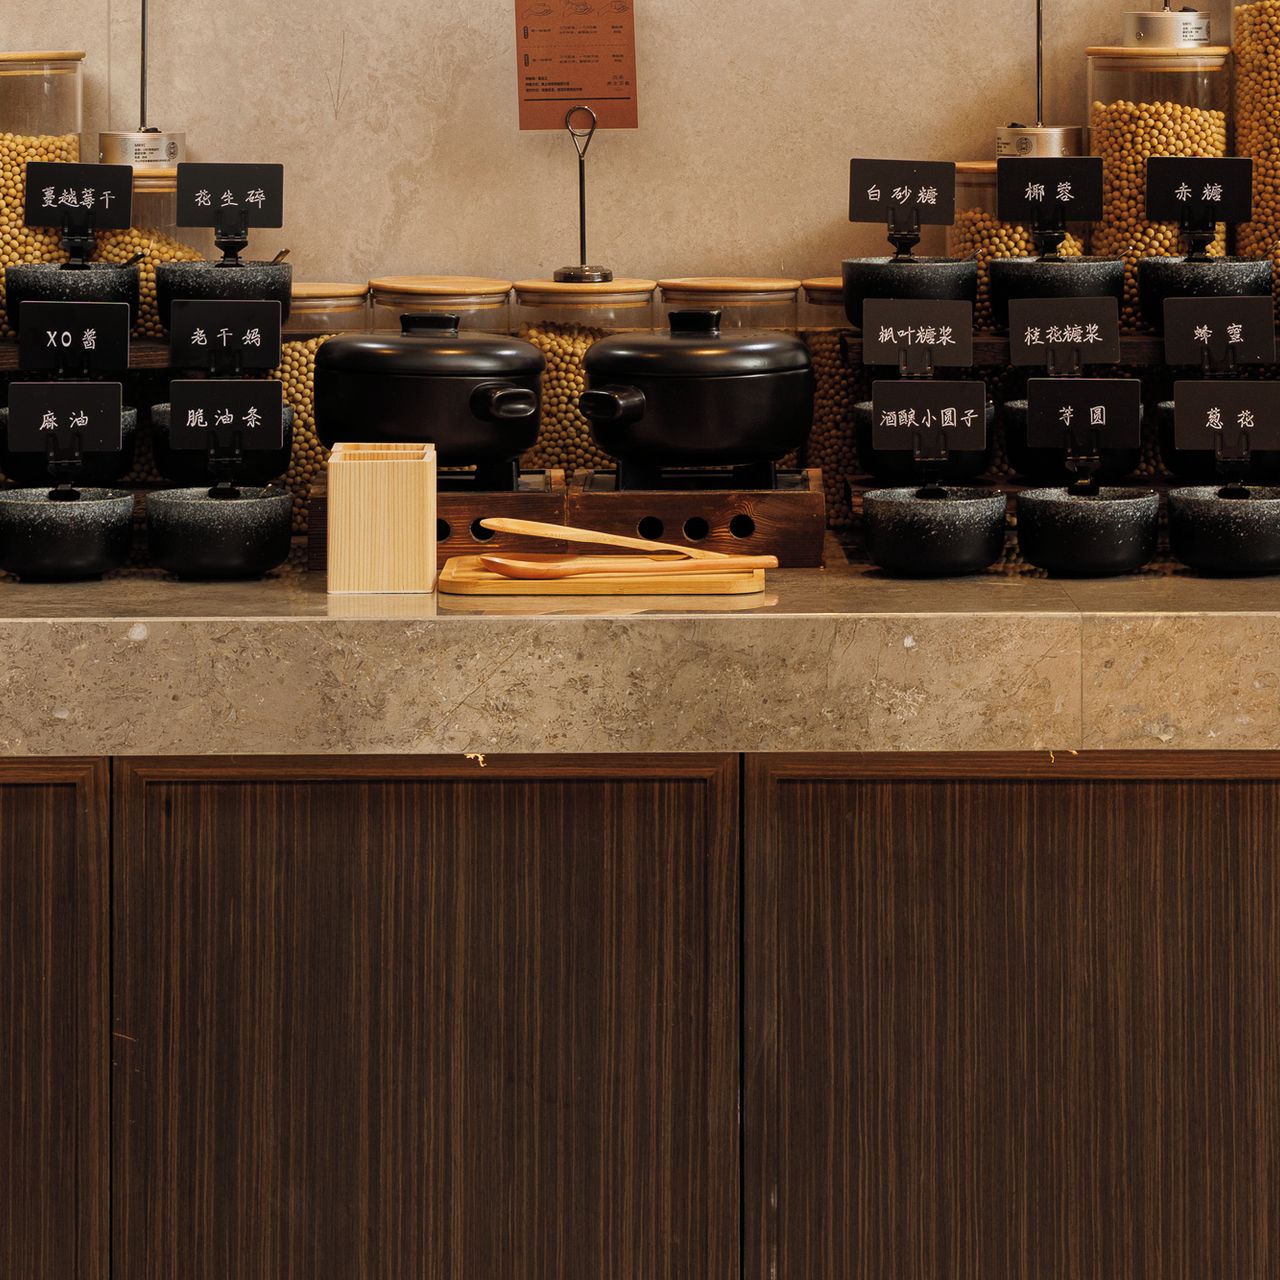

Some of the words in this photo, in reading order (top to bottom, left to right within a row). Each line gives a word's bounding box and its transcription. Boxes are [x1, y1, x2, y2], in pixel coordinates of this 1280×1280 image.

[41, 186, 116, 209] 蔓越莓干
[194, 187, 266, 209] 花生碎
[867, 184, 938, 205] 白砂糖
[1024, 181, 1075, 203] 椰蓉
[1174, 182, 1223, 202] 赤糖
[190, 327, 261, 347] 老干妈
[878, 325, 956, 346] 枫叶糖浆
[1024, 323, 1104, 346] 桂花糖浆
[1193, 322, 1244, 345] 蜂蜜
[39, 409, 89, 431] 麻油
[186, 406, 262, 428] 脆油条
[879, 407, 979, 428] 酒酿小圆子
[1059, 405, 1106, 427] 芋圆
[1205, 406, 1255, 430] 葱花
